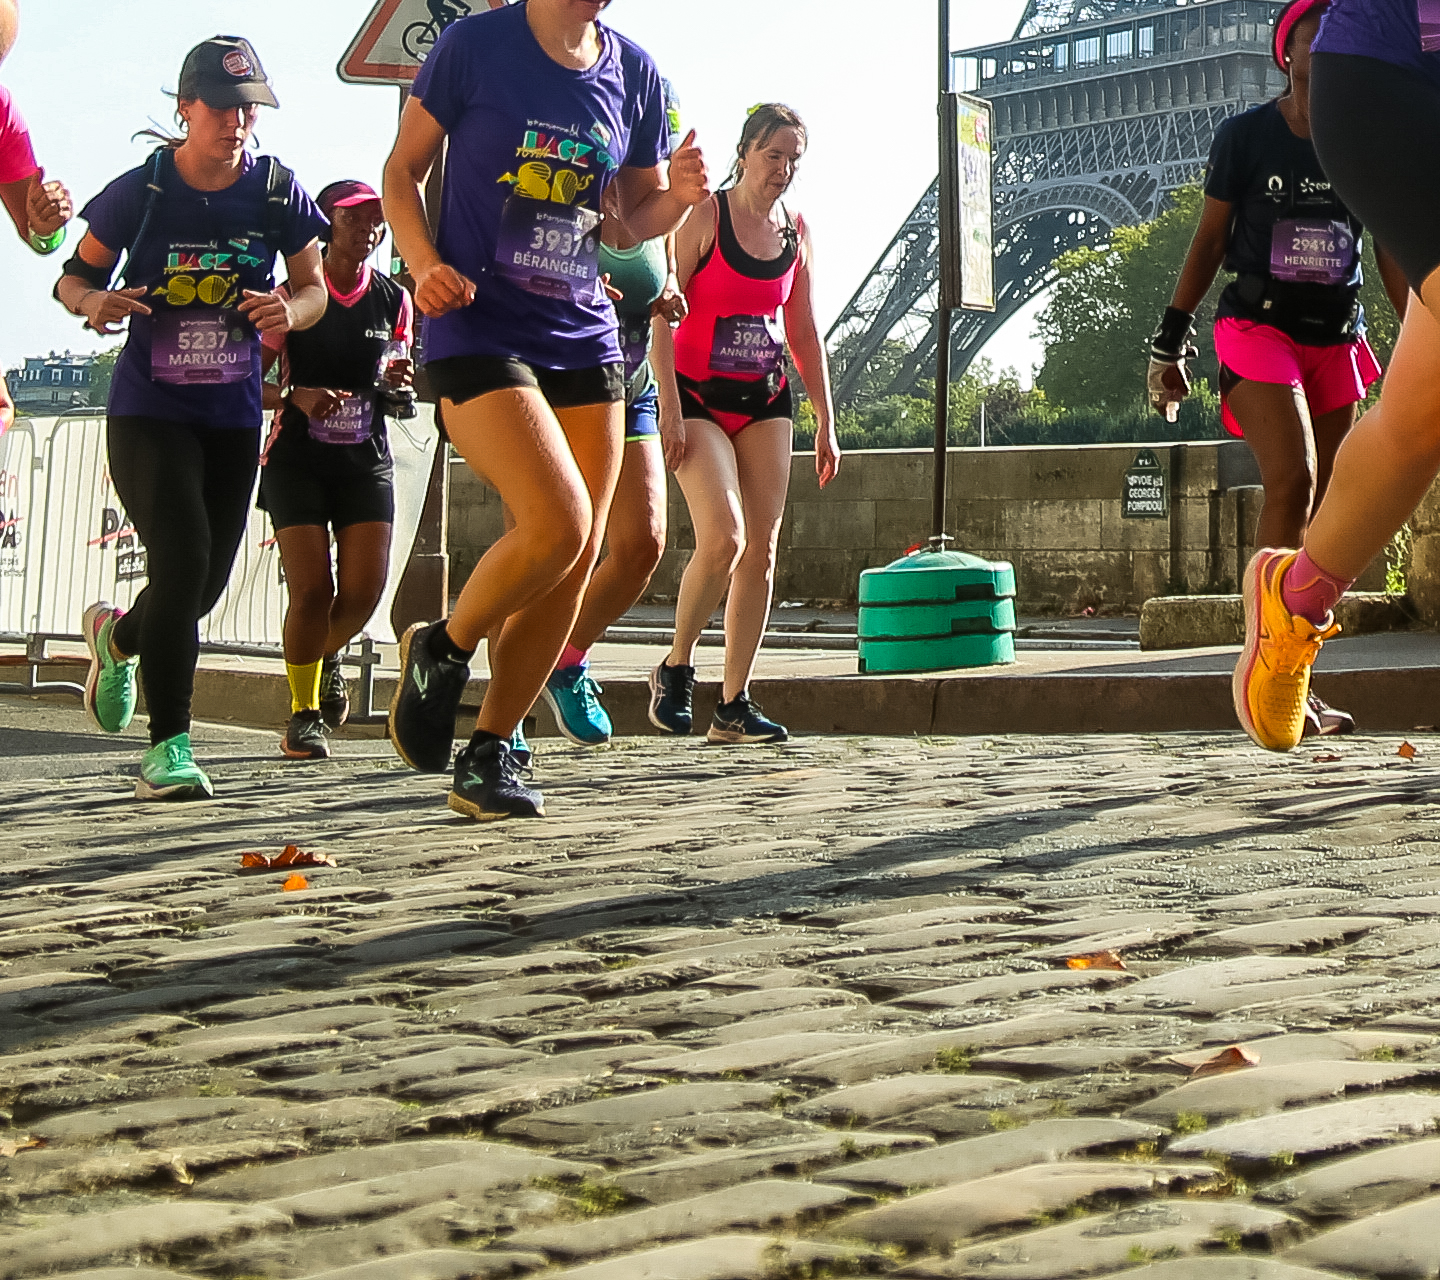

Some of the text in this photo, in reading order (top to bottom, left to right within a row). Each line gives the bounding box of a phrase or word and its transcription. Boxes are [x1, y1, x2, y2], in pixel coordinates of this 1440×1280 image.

[530, 226, 582, 257] 3937
[1292, 238, 1335, 253] 29416
[1284, 255, 1342, 268] HENRIETTE
[178, 331, 229, 350] 5237
[733, 331, 770, 347] 3946
[169, 353, 237, 366] MARYLOU
[720, 347, 748, 358] ANNE
[323, 419, 363, 429] NADINE
